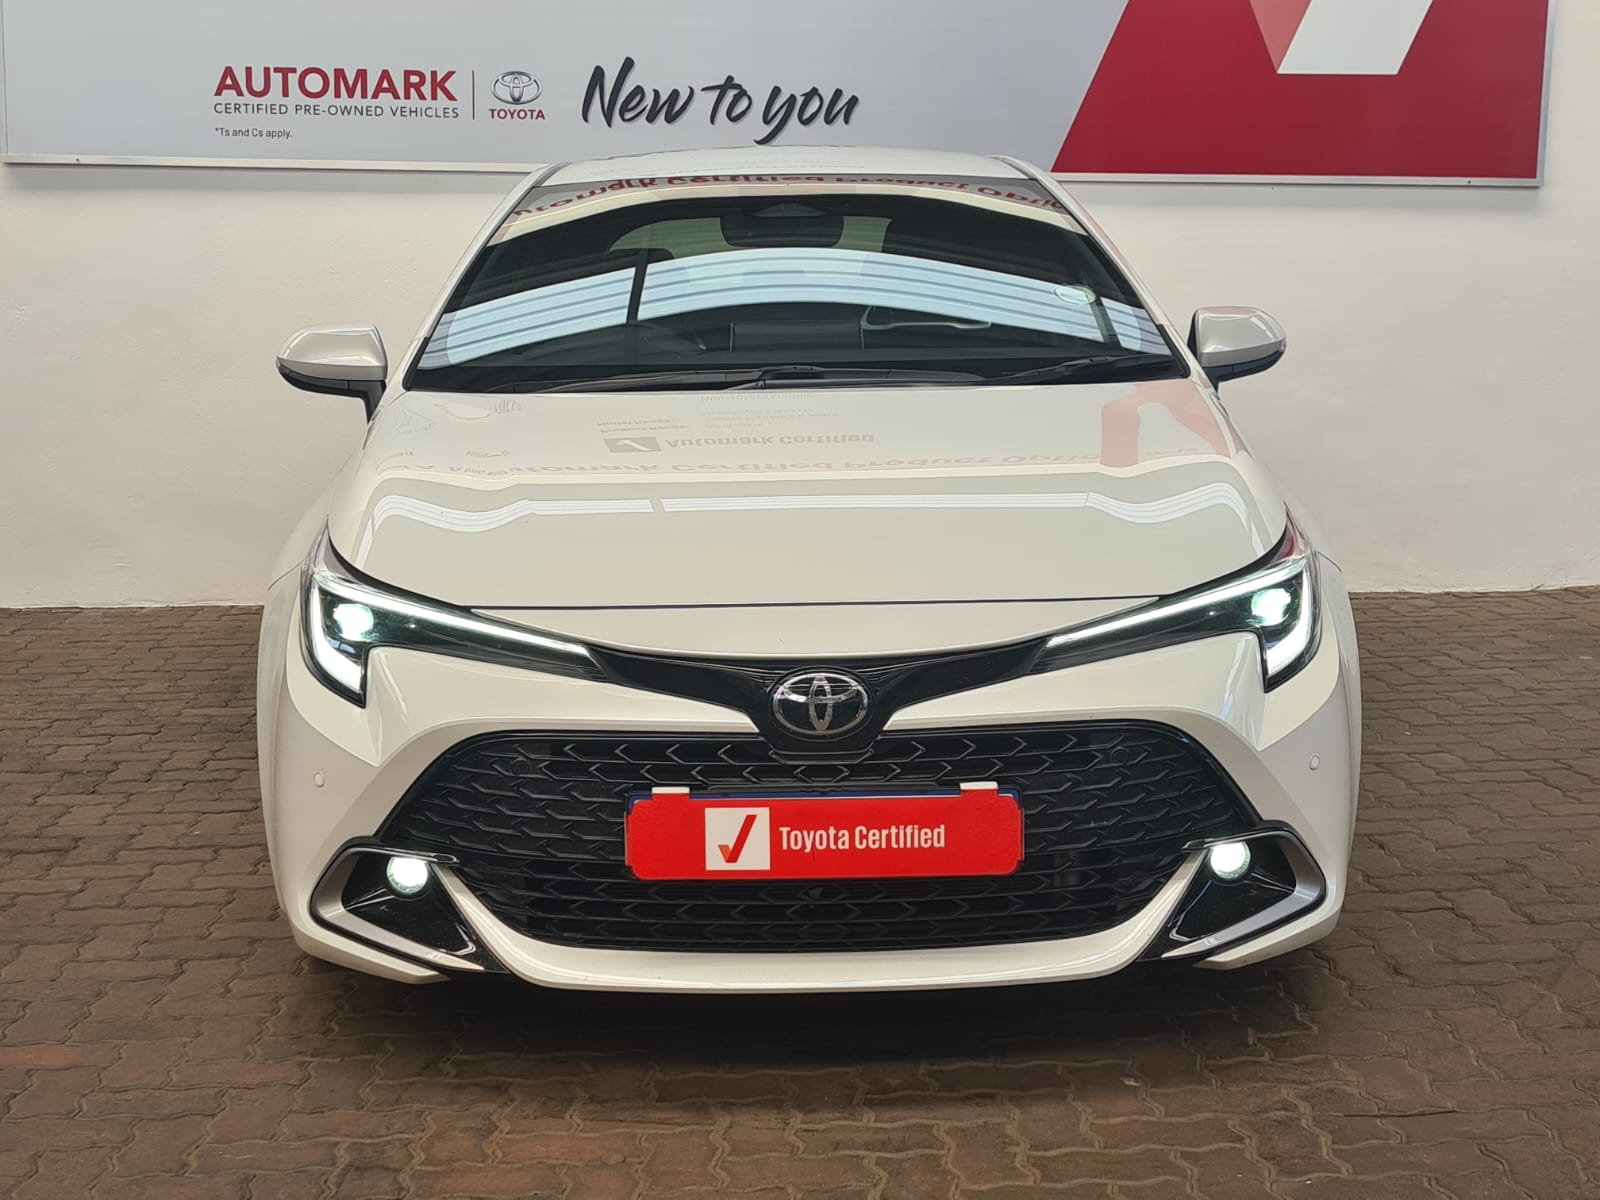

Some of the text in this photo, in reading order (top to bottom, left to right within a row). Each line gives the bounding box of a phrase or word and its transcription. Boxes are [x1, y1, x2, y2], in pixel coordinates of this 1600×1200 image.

[213, 65, 458, 102] AUTOMARK
[213, 102, 459, 119] CERTIFIED PRE-OWNED VEHICLES
[581, 56, 860, 145] New to you
[488, 108, 546, 121] TOYOTA
[232, 128, 249, 138] and
[251, 128, 264, 138] Cs
[265, 128, 293, 140] apply.
[779, 823, 946, 853] Toyota Certified
